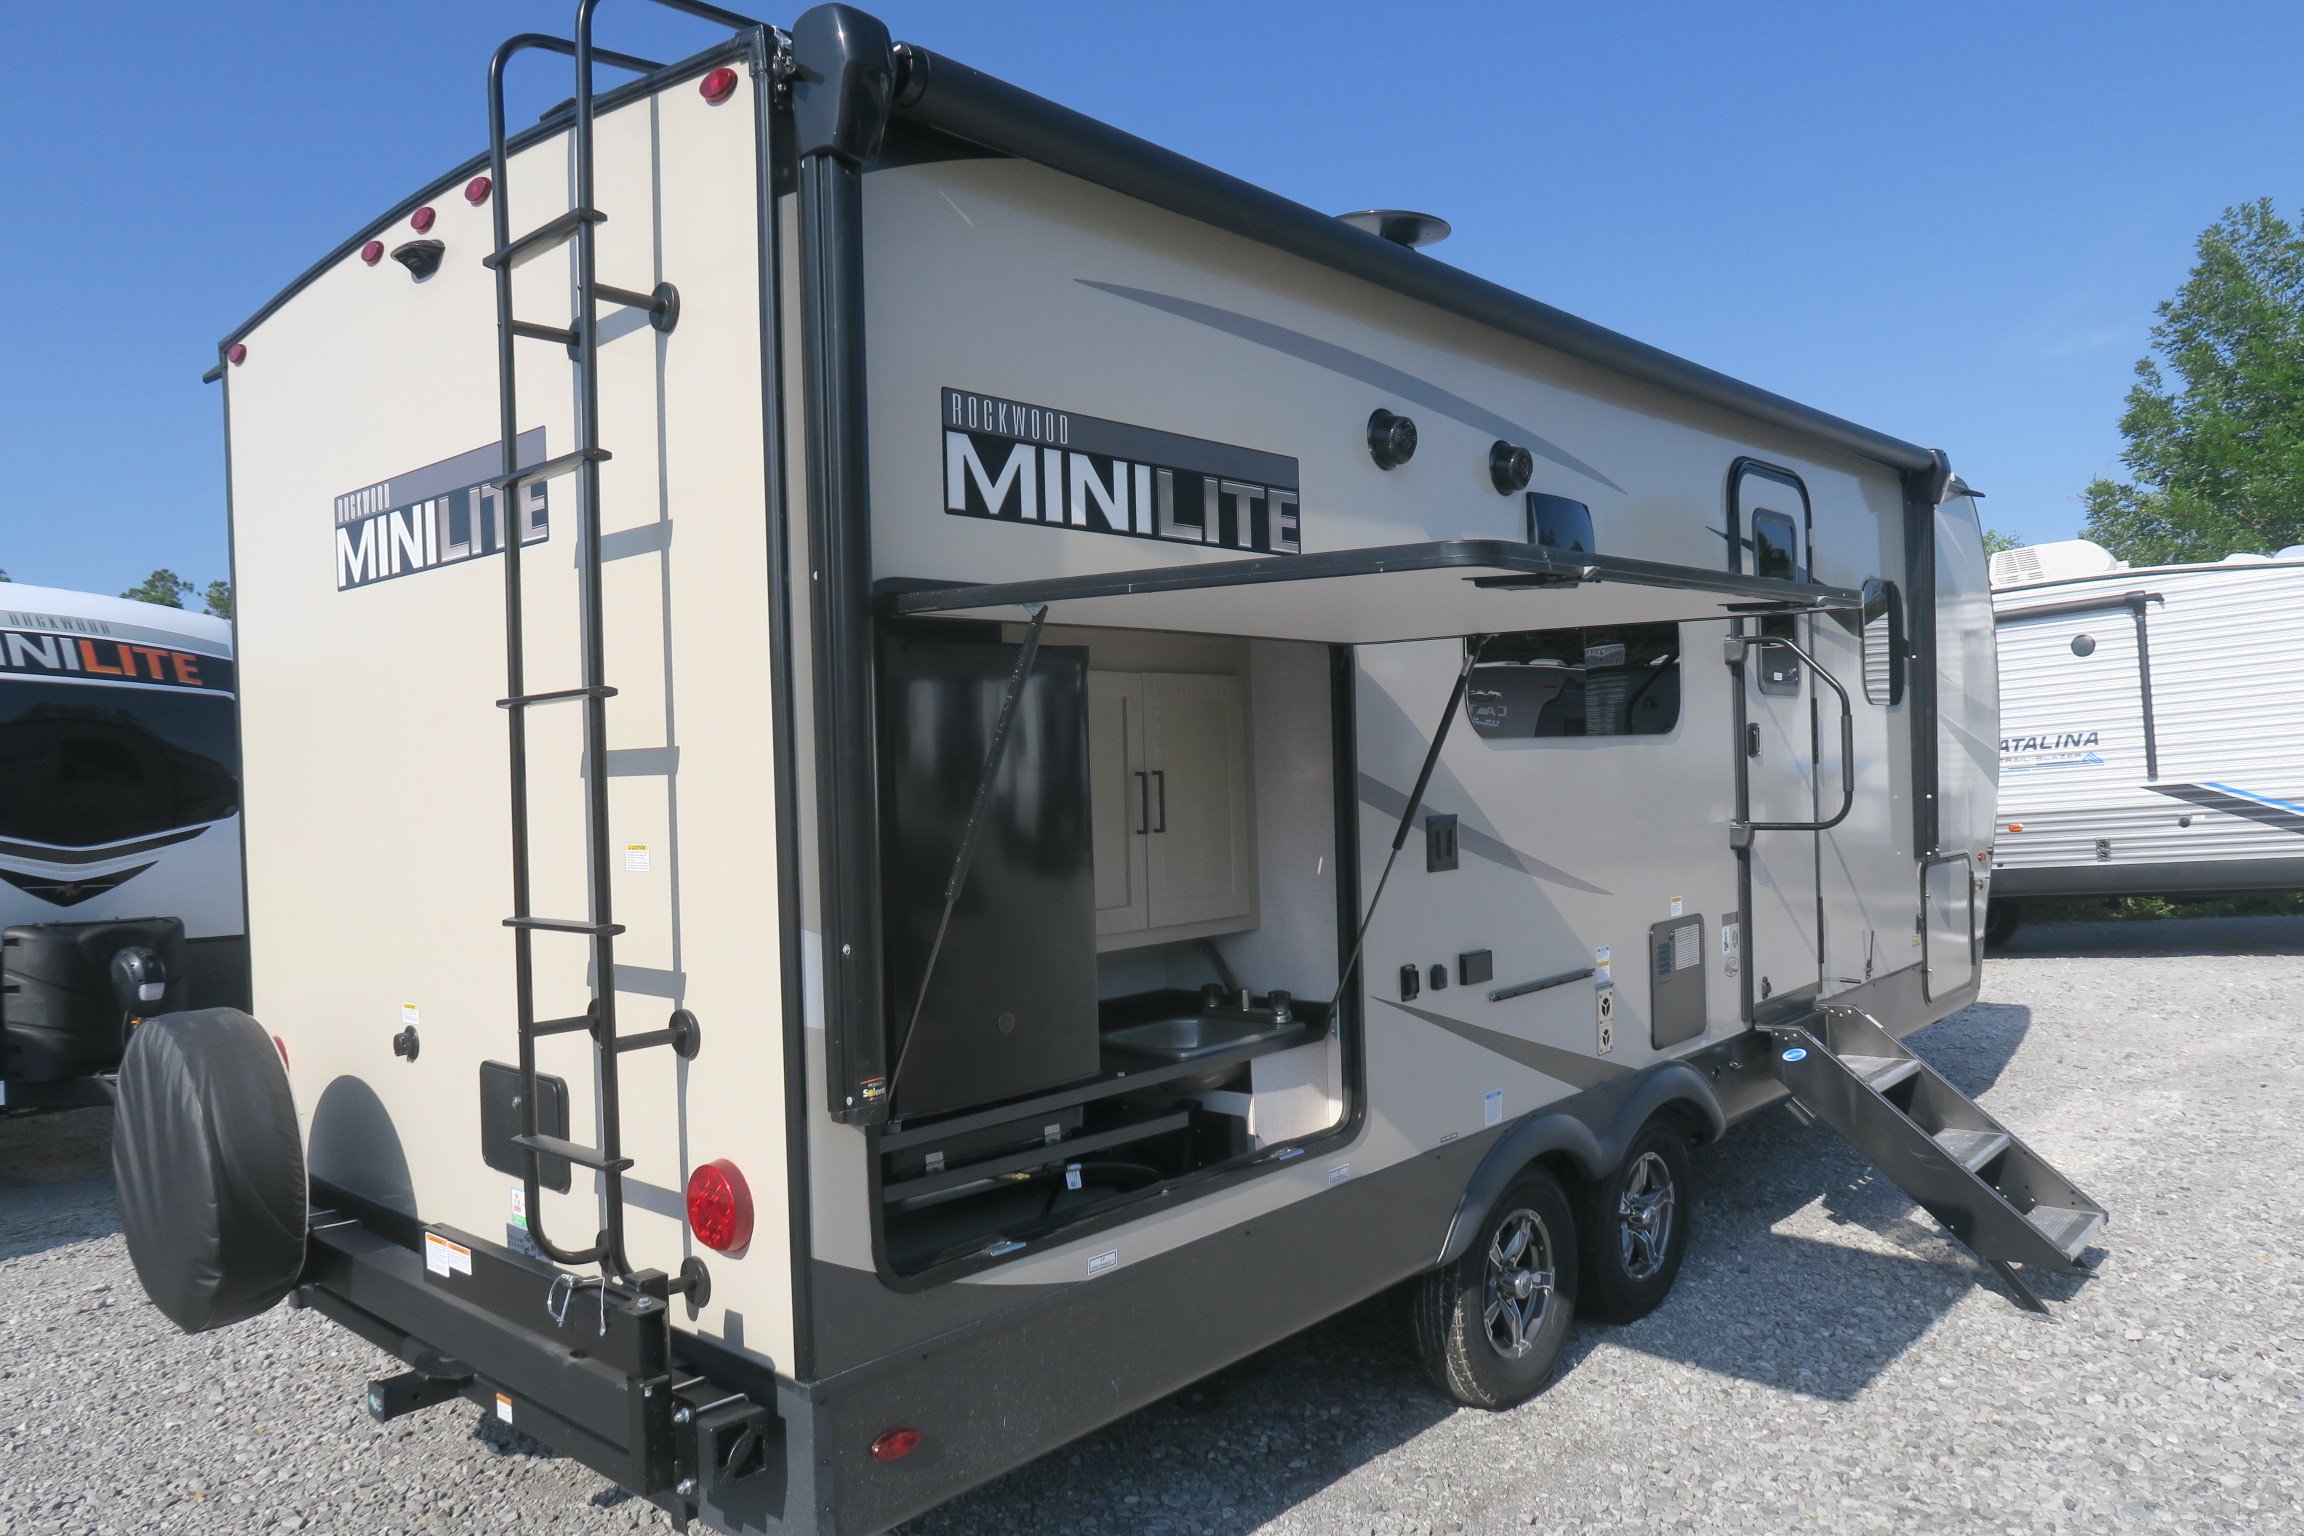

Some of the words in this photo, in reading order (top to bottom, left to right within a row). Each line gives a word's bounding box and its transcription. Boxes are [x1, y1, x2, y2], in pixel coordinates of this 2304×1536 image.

[951, 391, 1069, 445] ROCKWOOD
[337, 482, 390, 523] ROCKWOOD
[2000, 731, 2099, 752] ATALINA
